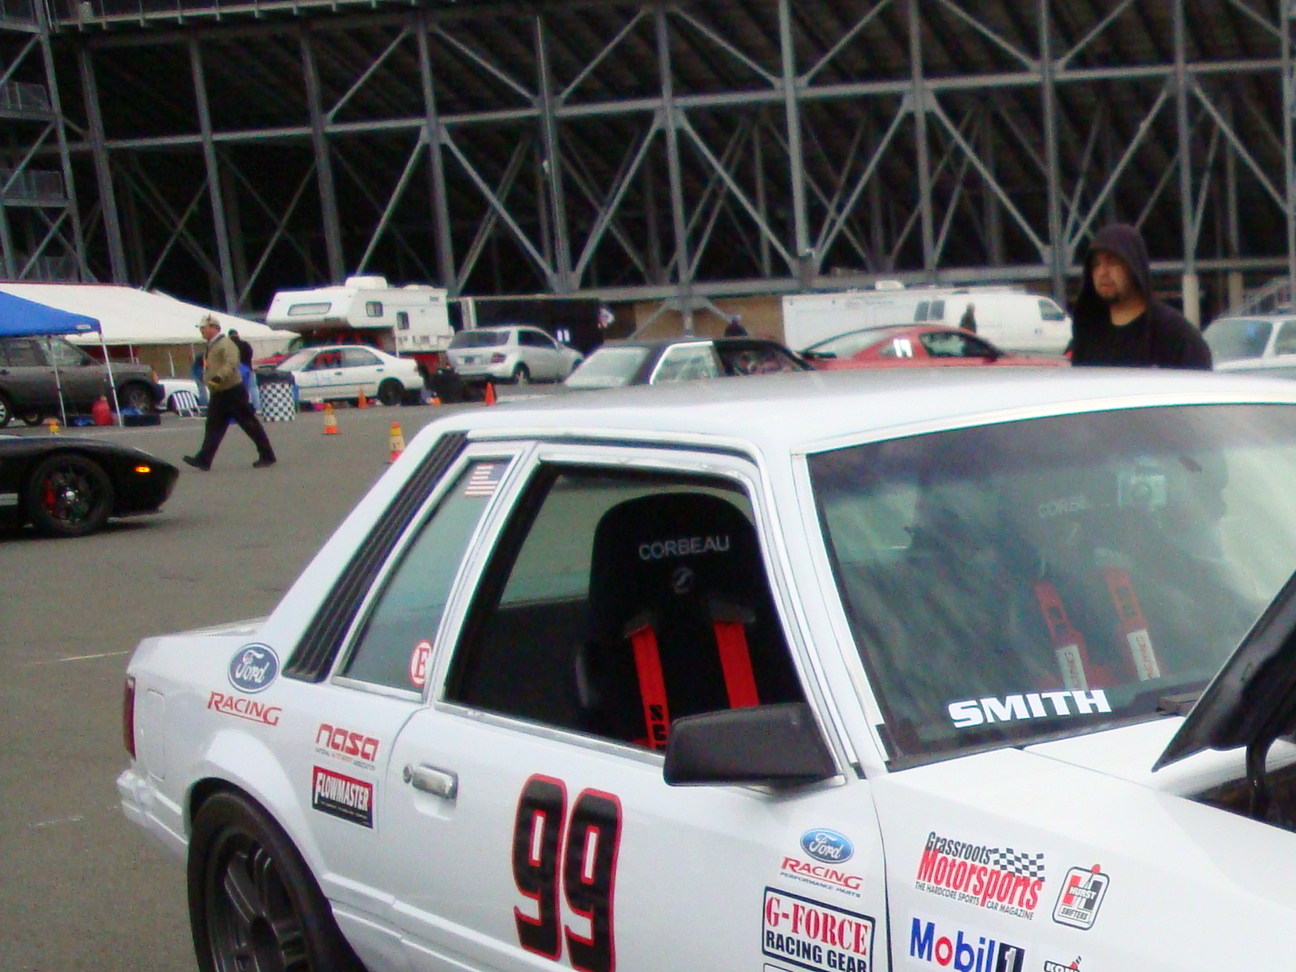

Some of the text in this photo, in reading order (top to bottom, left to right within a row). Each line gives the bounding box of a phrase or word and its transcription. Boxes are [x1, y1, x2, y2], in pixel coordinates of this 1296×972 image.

[638, 535, 730, 561] CORBEAU
[235, 648, 268, 685] Ford
[207, 691, 282, 727] RACING
[948, 689, 1112, 728] SMITH
[314, 771, 370, 812] FLOWMASTER
[809, 833, 844, 860] Ford
[925, 831, 992, 865] Grassroots
[780, 856, 864, 891] RACING
[917, 847, 1042, 911] Motorsports
[915, 881, 1035, 921] THE HARDCORE SPORTS CAR MAGAZINE
[1068, 886, 1097, 900] HURST
[765, 896, 868, 956] G-FORCE
[766, 930, 823, 965] RACING
